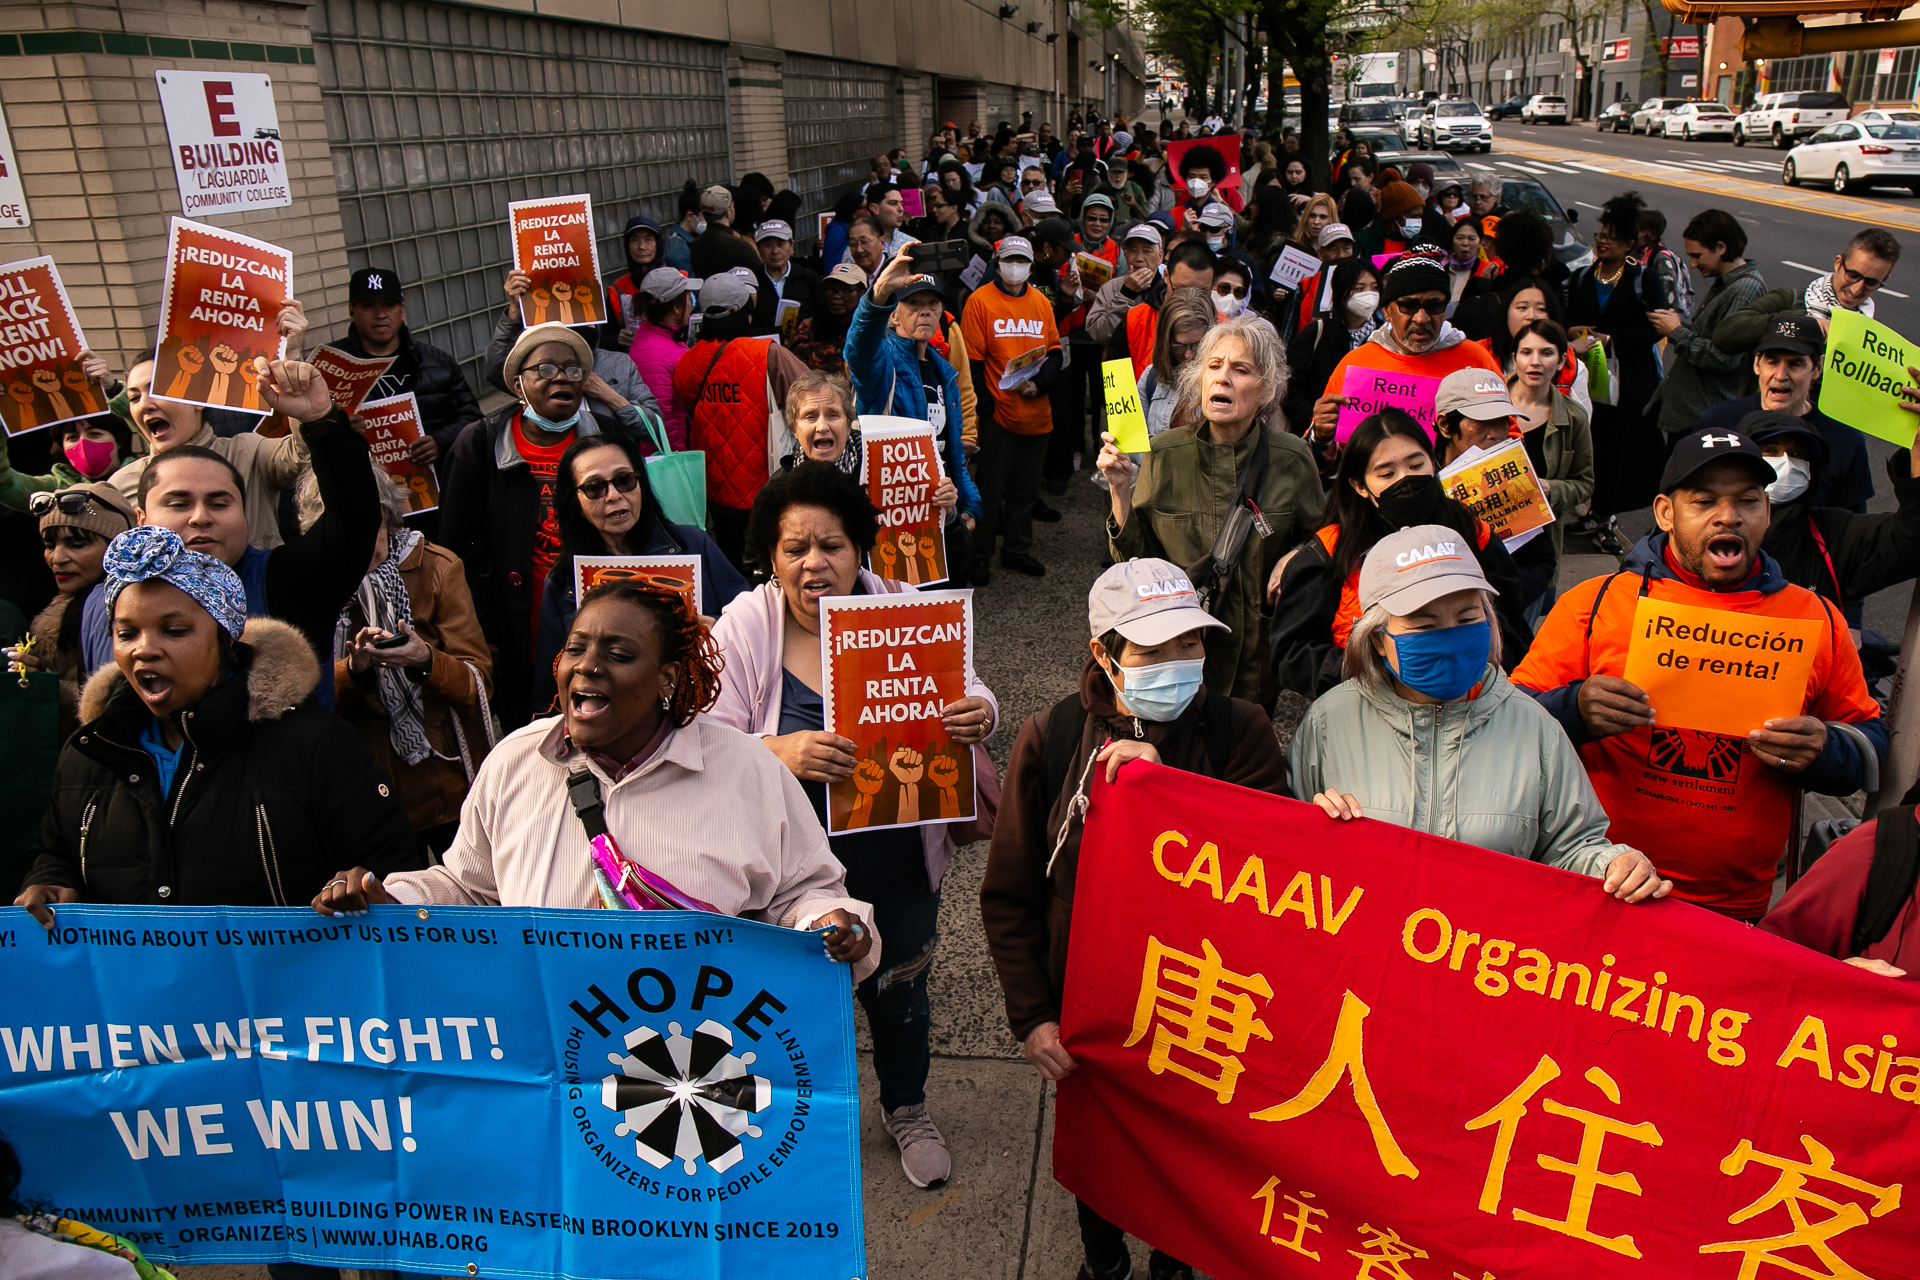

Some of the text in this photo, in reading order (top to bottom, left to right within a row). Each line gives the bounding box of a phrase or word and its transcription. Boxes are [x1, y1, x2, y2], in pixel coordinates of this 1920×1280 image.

[203, 81, 241, 137] E
[179, 140, 279, 170] BUILDING
[198, 168, 269, 189] LAGUARDIA
[185, 186, 286, 209] COMMUNITY COLLEGE
[517, 213, 586, 234] ¡REDUZCAN
[544, 230, 561, 242] LA
[534, 242, 575, 256] RENTA
[180, 246, 284, 282] ¡REDUZCAN
[531, 255, 581, 271] AHORA!
[0, 275, 37, 301] LL
[221, 272, 245, 290] LA
[0, 296, 50, 323] ACK
[200, 288, 261, 313] RENTA
[189, 306, 265, 332] AHORA!
[0, 337, 68, 371] NOW!
[1862, 329, 1905, 366] Rent
[328, 390, 354, 399] ENTA
[335, 381, 352, 390] LA
[1374, 378, 1417, 397] Rent
[365, 410, 414, 429] DUZCAN
[376, 429, 393, 440] LA
[882, 441, 926, 464] ROLL
[880, 461, 931, 486] BACK
[881, 483, 930, 507] RENT
[877, 503, 930, 528] NOW!
[1481, 498, 1533, 522] OLLBACK
[1490, 518, 1508, 531] OW!
[1395, 542, 1456, 567] CAAAV
[835, 622, 962, 655] ¡REDUZCAN
[1645, 615, 1804, 653] ¡Reducción
[887, 652, 917, 672] LA
[1657, 649, 1781, 681] de renta!
[866, 675, 939, 699] RENTA
[857, 698, 944, 725] AHORA!
[1643, 771, 1737, 795] new settlement
[0, 929, 16, 947] Y!
[47, 925, 734, 951] NOTHING ABOUT US WITHOUT US IS FOR US! EVICTION FREE NY!
[1151, 829, 1920, 1104] CAAAV Organizing Asia
[569, 965, 787, 1043] HOPE
[1, 1017, 504, 1072] WHEN WE FIGHT!
[564, 1026, 813, 1202] HOUSING ORGANIZERS FOR PEOPLE EMPOWERMENT
[109, 1097, 418, 1160] WE WIN!
[184, 1199, 287, 1217] MEMBERS
[291, 1202, 389, 1220] BUILDING
[395, 1203, 468, 1222] POWER
[473, 1207, 494, 1224] IN
[500, 1209, 585, 1236] EASTERN
[592, 1218, 709, 1240] BROOKLYN
[714, 1222, 780, 1242] SINCE
[786, 1222, 839, 1239] 2019
[1251, 1175, 1497, 1280] 住客
[110, 1225, 307, 1249] OPE_ORGANIZERS
[322, 1227, 488, 1253] WWW.UHAB.ORG
